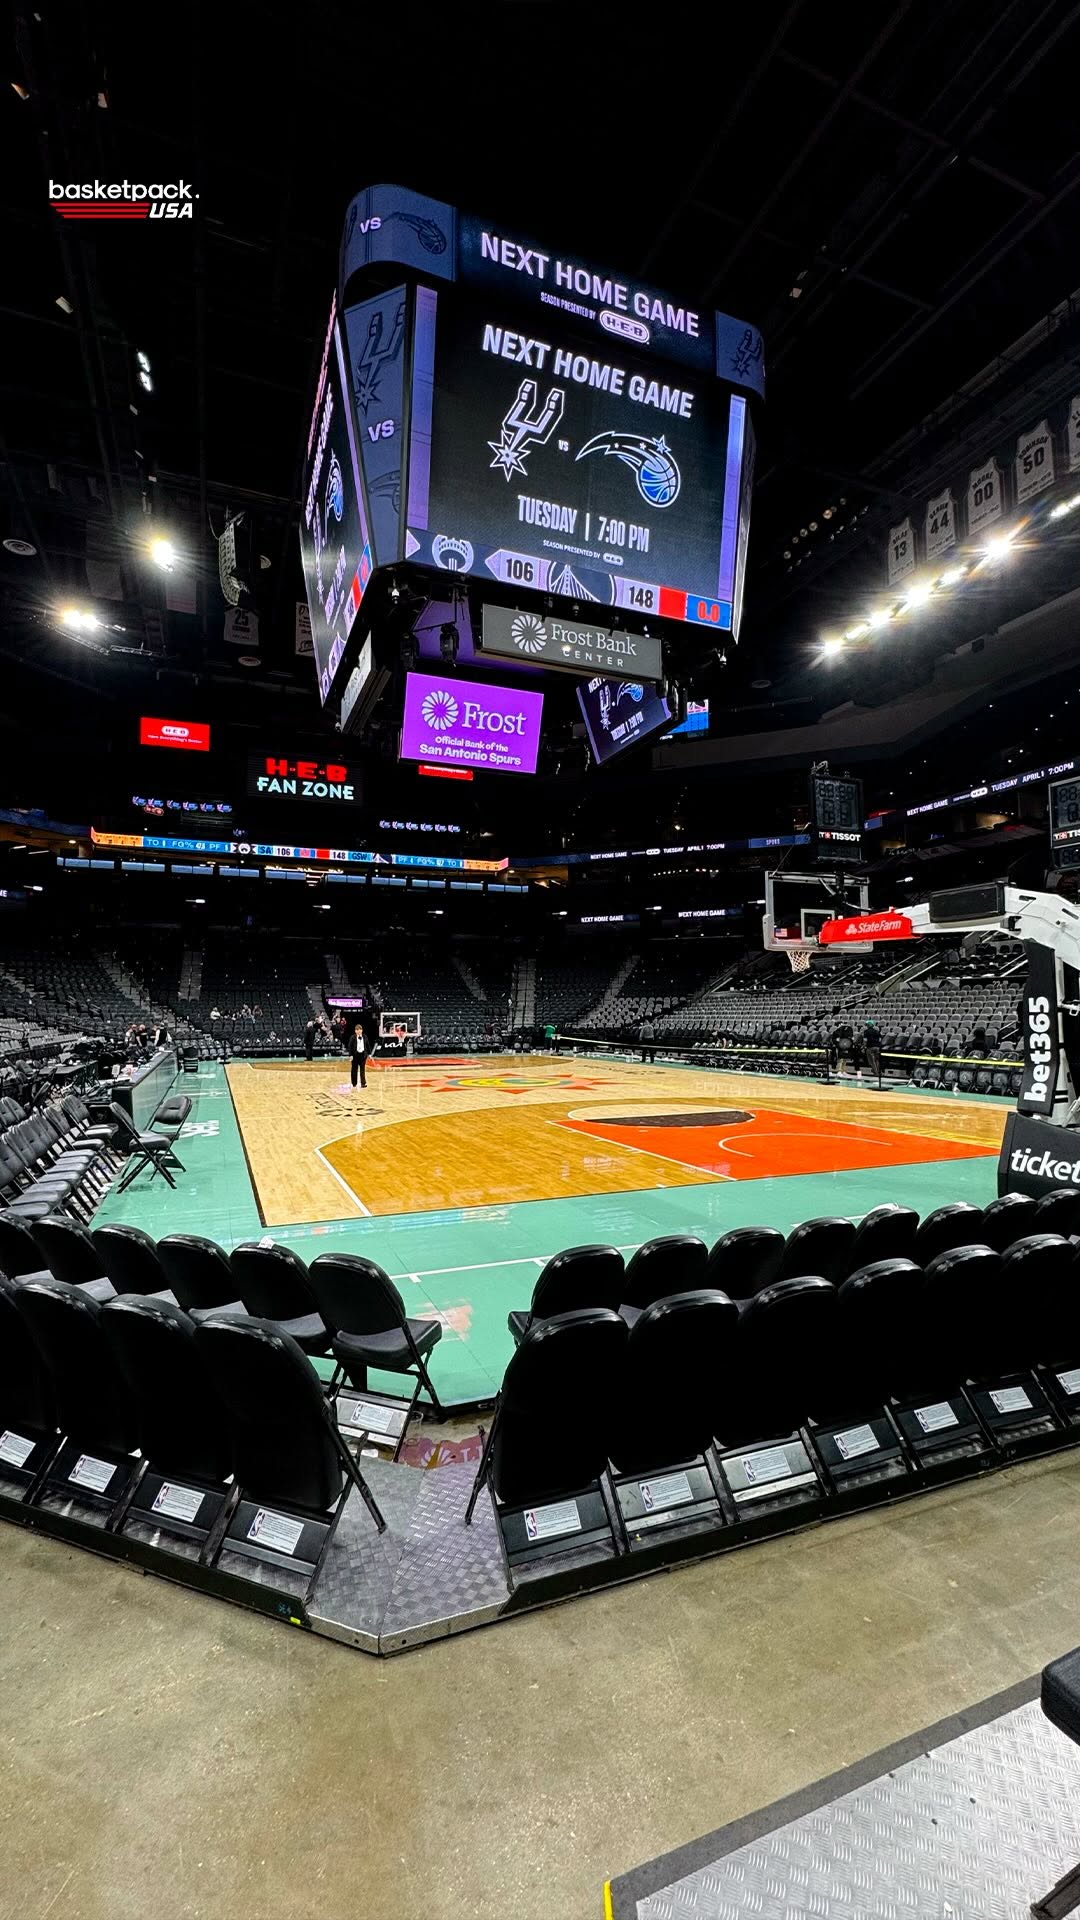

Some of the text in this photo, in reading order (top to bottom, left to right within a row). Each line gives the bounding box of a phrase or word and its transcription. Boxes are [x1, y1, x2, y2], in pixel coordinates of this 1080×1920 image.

[481, 232, 699, 338] NEXT HOME GAME
[482, 324, 694, 418] NEXT HOME GAME
[1023, 447, 1044, 475] 50
[974, 482, 993, 507] 00
[517, 495, 650, 553] TUESDAY 7:00 PM
[930, 510, 949, 534] 44
[894, 541, 907, 561] 13
[506, 558, 533, 582] 106
[629, 586, 653, 609] 148
[234, 609, 249, 626] 25
[697, 601, 720, 622] 0.0
[551, 624, 637, 656] Frost Bank
[562, 648, 623, 667] CENTER
[462, 702, 526, 735] Frost
[420, 743, 521, 765] San Antonio Spurs
[435, 735, 508, 752] Official Bank of the
[266, 757, 347, 782] H-E-B
[257, 777, 354, 800] FAN ZONE
[992, 778, 1018, 791] TUESDAY
[1022, 772, 1041, 783] APRIL
[906, 799, 948, 816] NEXT HOME GAME
[831, 832, 861, 841] TISSOT
[260, 846, 290, 856] SA 106
[1024, 996, 1051, 1102] bet365
